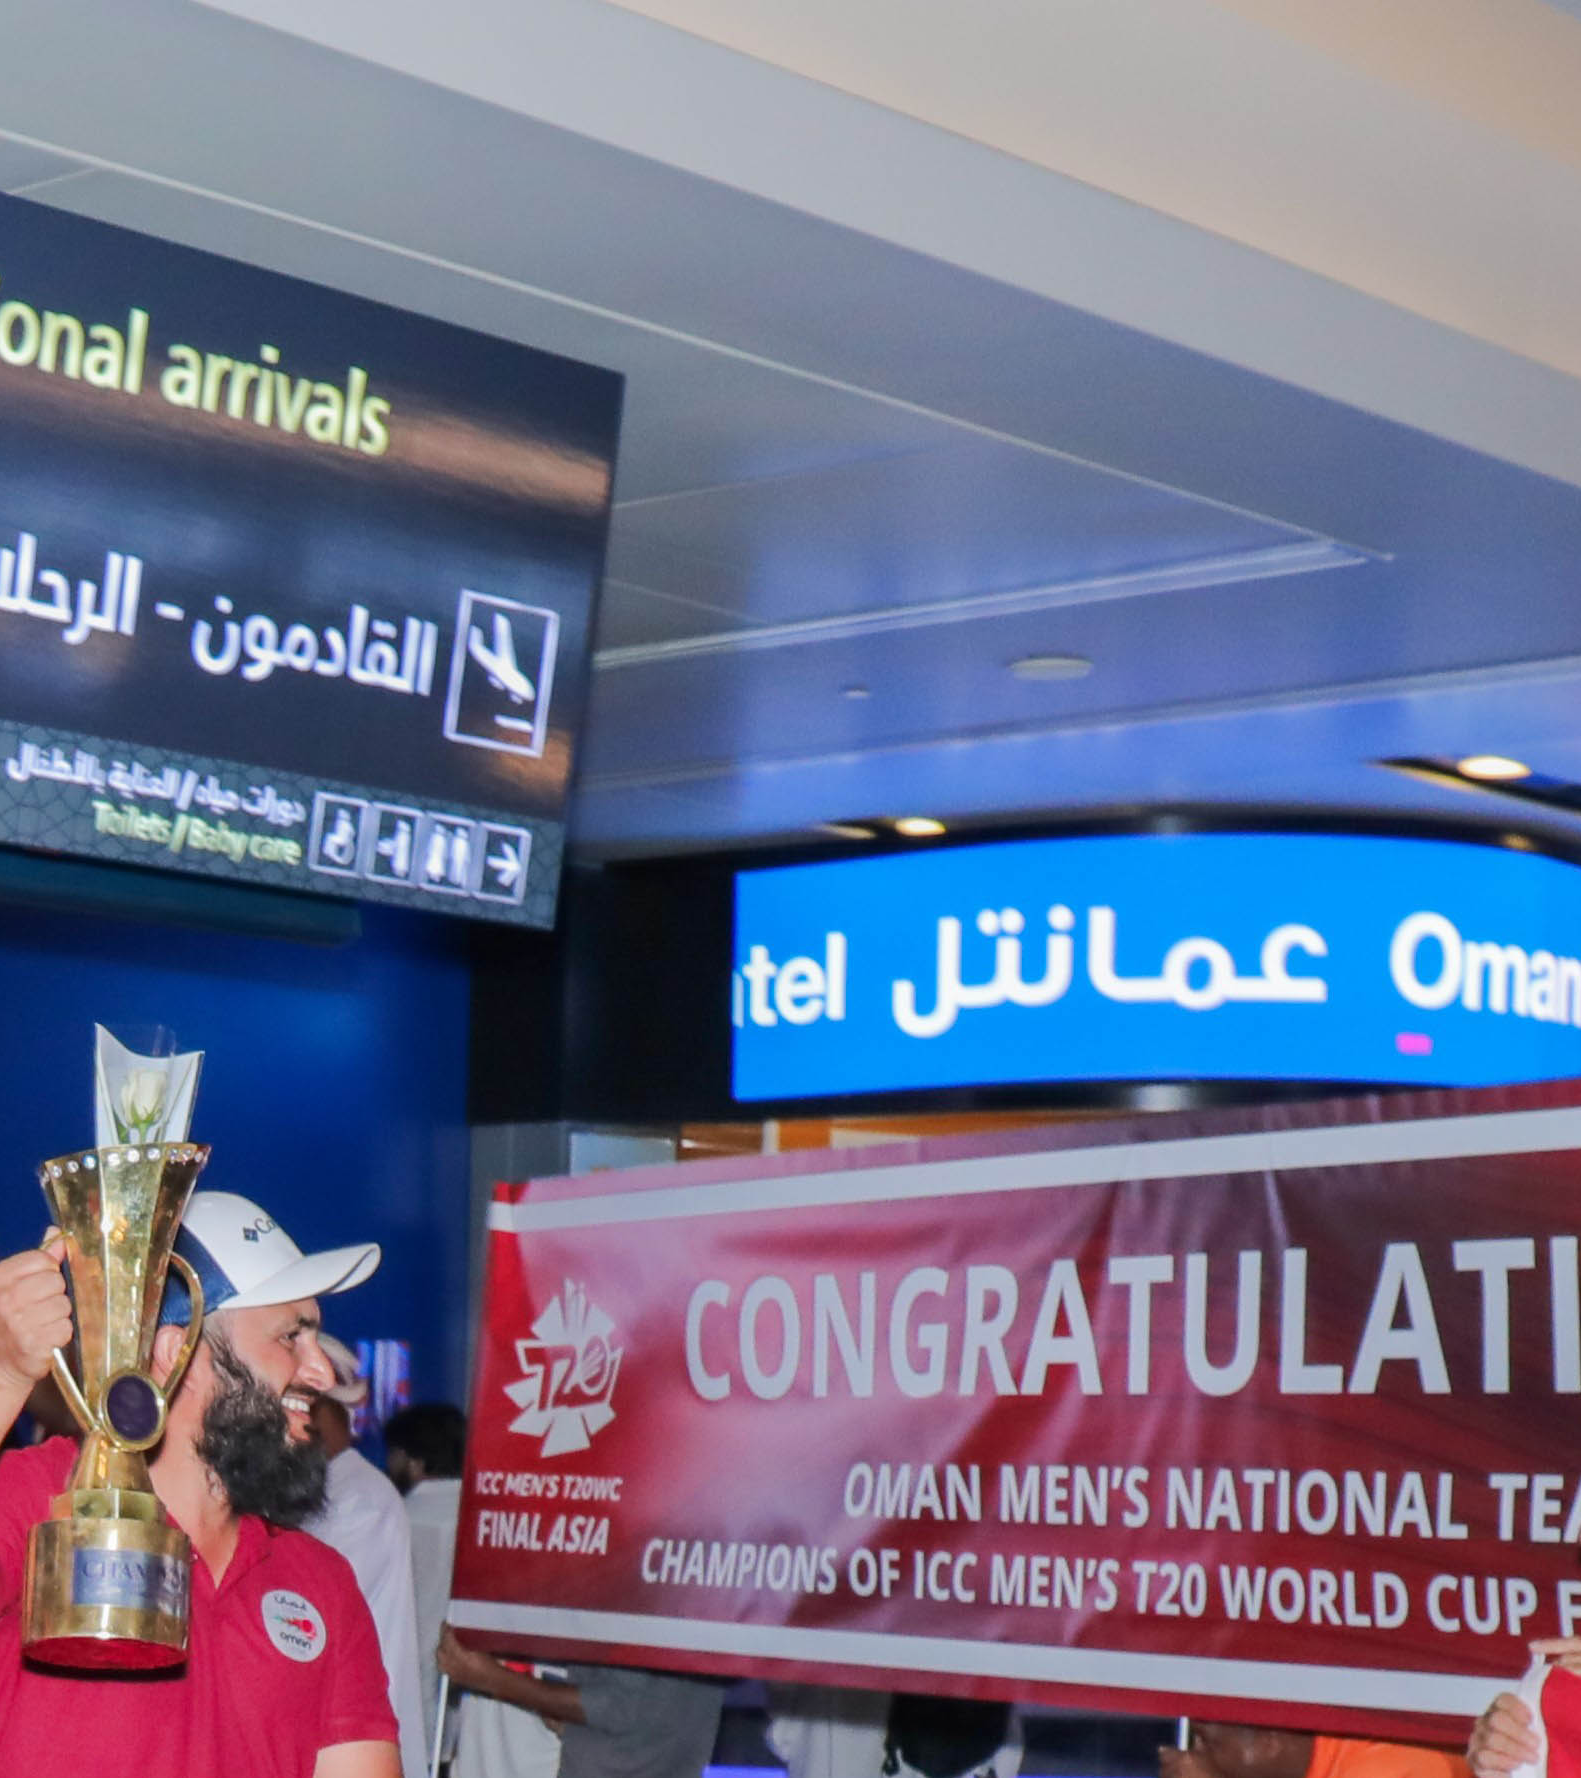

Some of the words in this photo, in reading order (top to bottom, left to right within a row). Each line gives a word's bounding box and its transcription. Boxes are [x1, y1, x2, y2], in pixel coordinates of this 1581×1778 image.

[160, 330, 391, 458] arrivals
[191, 601, 436, 698] القادمون
[734, 931, 848, 1030] tel
[892, 905, 1328, 1038] عمانتل
[475, 1471, 501, 1496] ICC
[503, 1472, 562, 1500] MEN'S
[563, 1475, 624, 1502] T20WC
[476, 1509, 544, 1552] FINAL
[547, 1514, 610, 1556] ASIA
[844, 1462, 981, 1522] OMAN
[1166, 1466, 1469, 1541] NATIONAL
[641, 1535, 838, 1596] CHAMPIONS
[849, 1548, 900, 1599] OF
[913, 1550, 978, 1603] ICC
[1132, 1562, 1207, 1619] T20
[1219, 1563, 1410, 1630] WORLD
[1426, 1574, 1538, 1637] CUP
